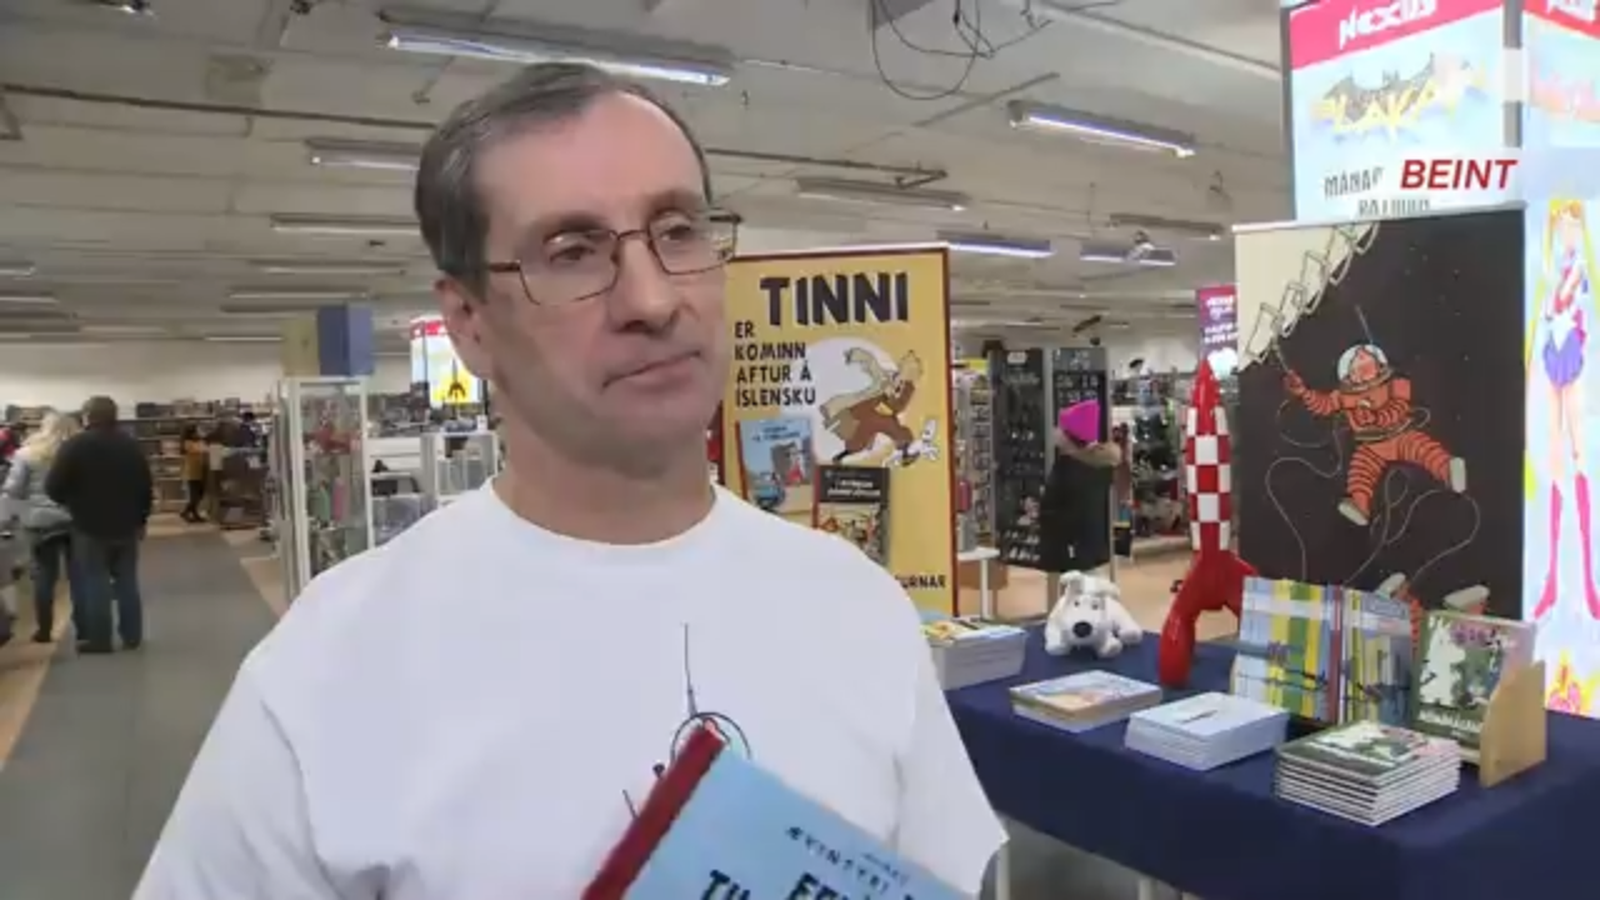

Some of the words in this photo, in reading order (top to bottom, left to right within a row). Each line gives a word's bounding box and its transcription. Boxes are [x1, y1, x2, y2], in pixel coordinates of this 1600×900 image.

[760, 272, 908, 326] TINNI
[735, 321, 755, 338] ER
[735, 341, 806, 361] KOMINN
[737, 364, 792, 383] AFTUR
